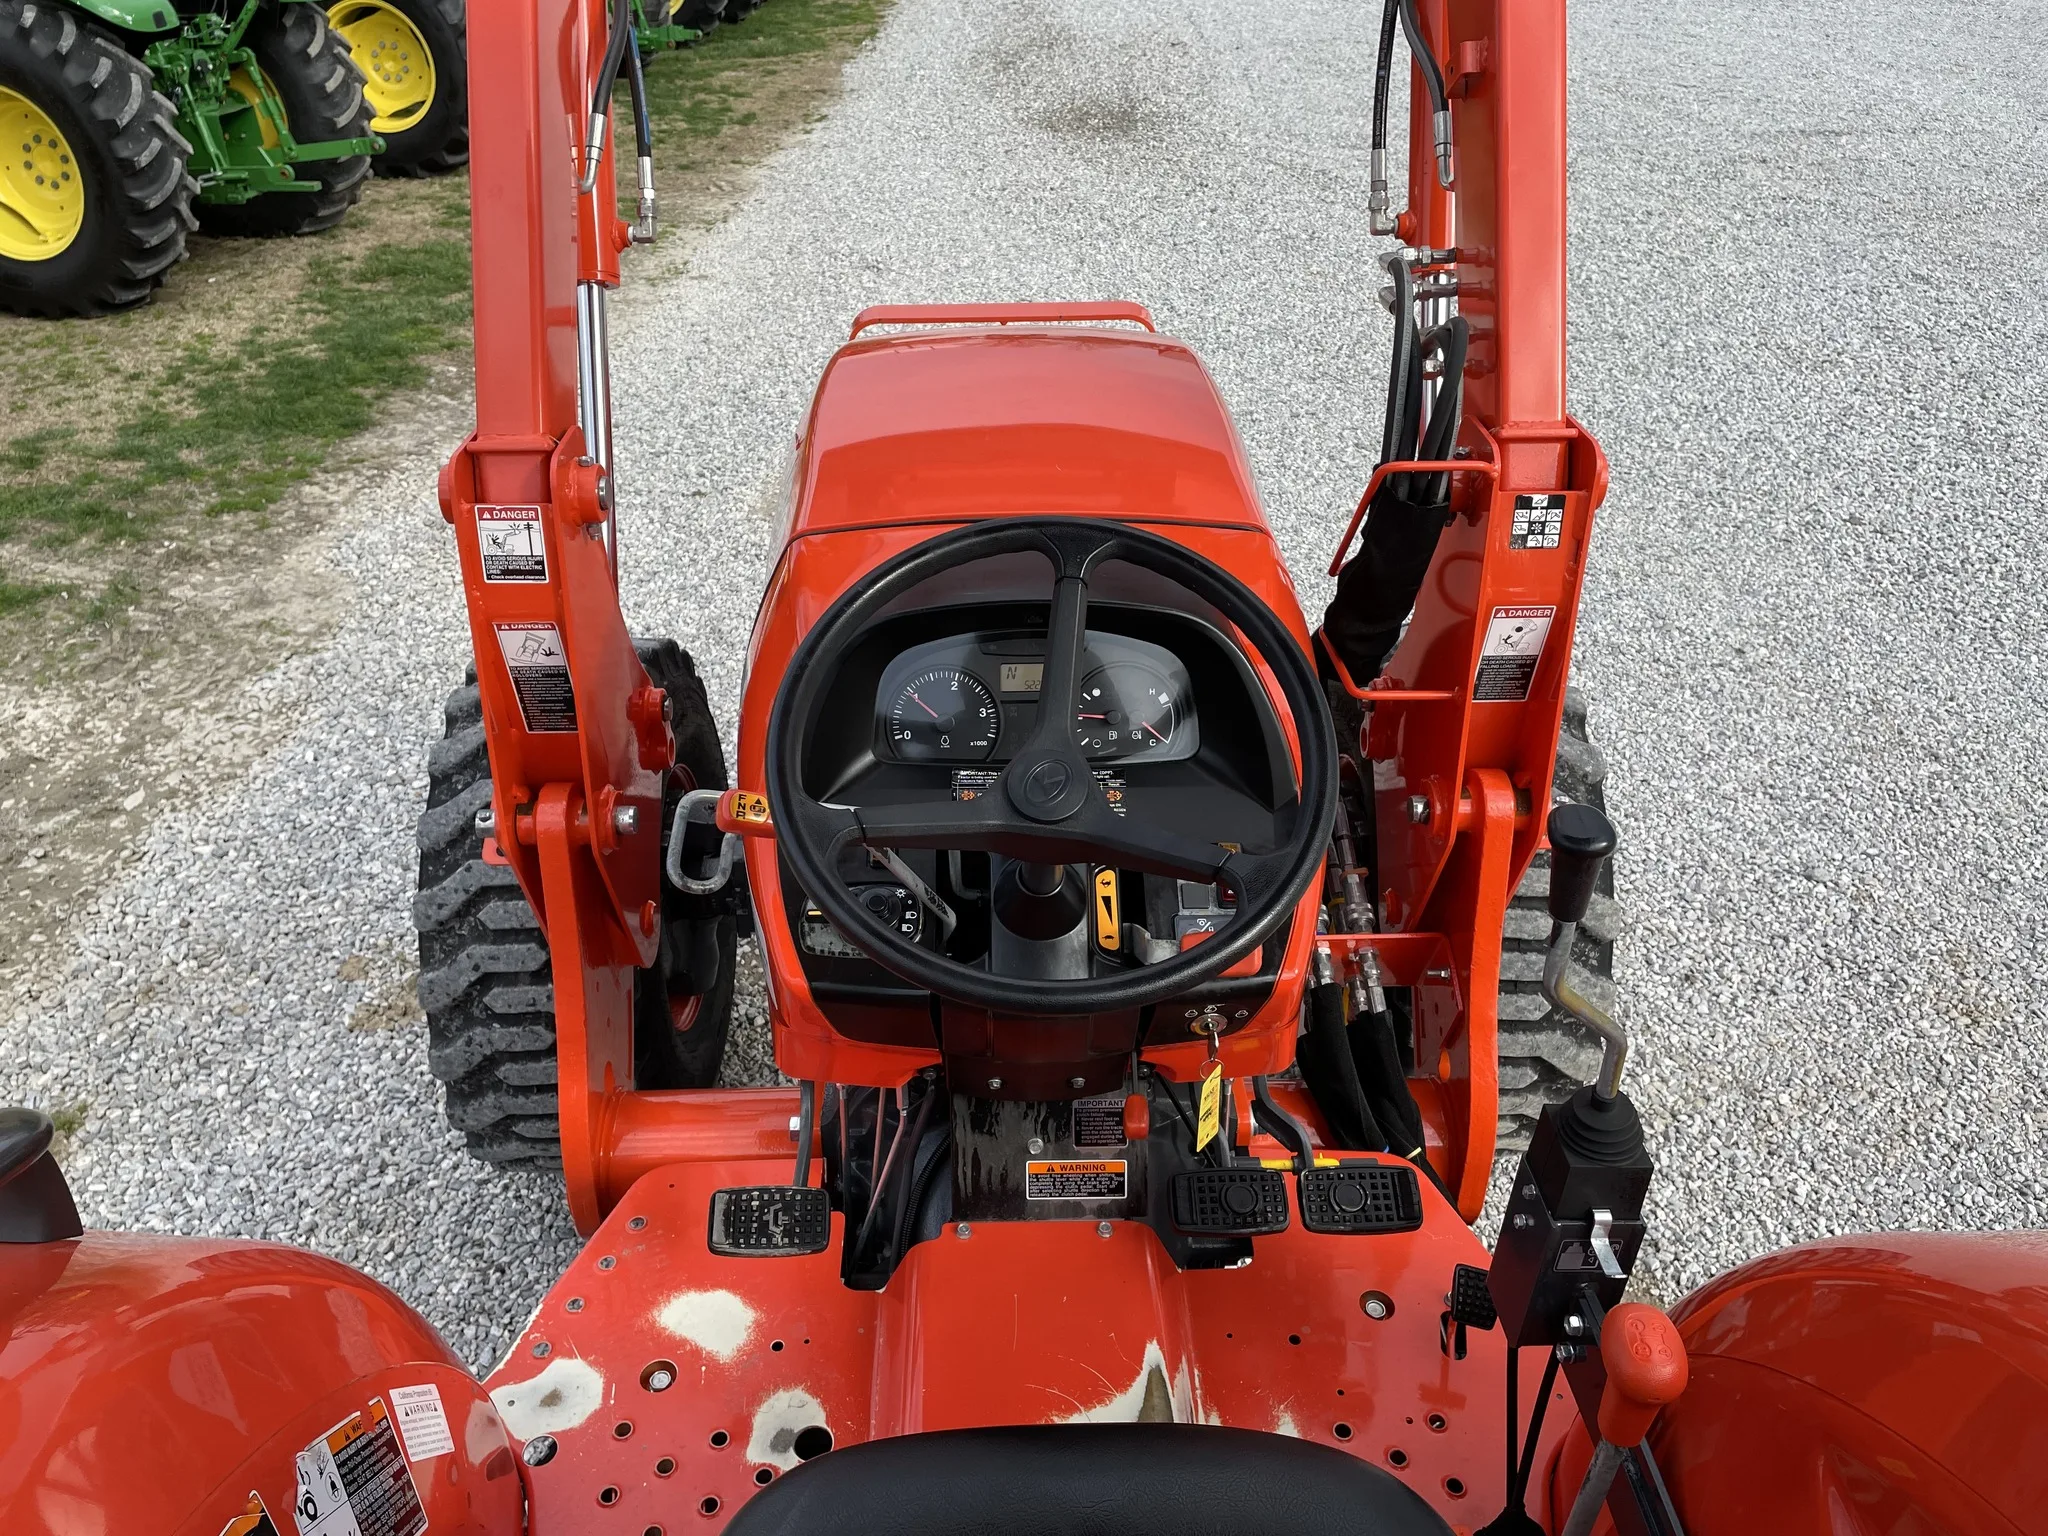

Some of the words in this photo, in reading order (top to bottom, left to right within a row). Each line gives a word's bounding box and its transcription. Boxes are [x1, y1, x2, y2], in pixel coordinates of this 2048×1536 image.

[1006, 667, 1017, 680] N
[951, 682, 958, 690] 2
[979, 708, 987, 717] 3
[904, 731, 911, 740] 0
[738, 802, 746, 810] N
[736, 810, 746, 820] R
[408, 1403, 433, 1415] WARNING
